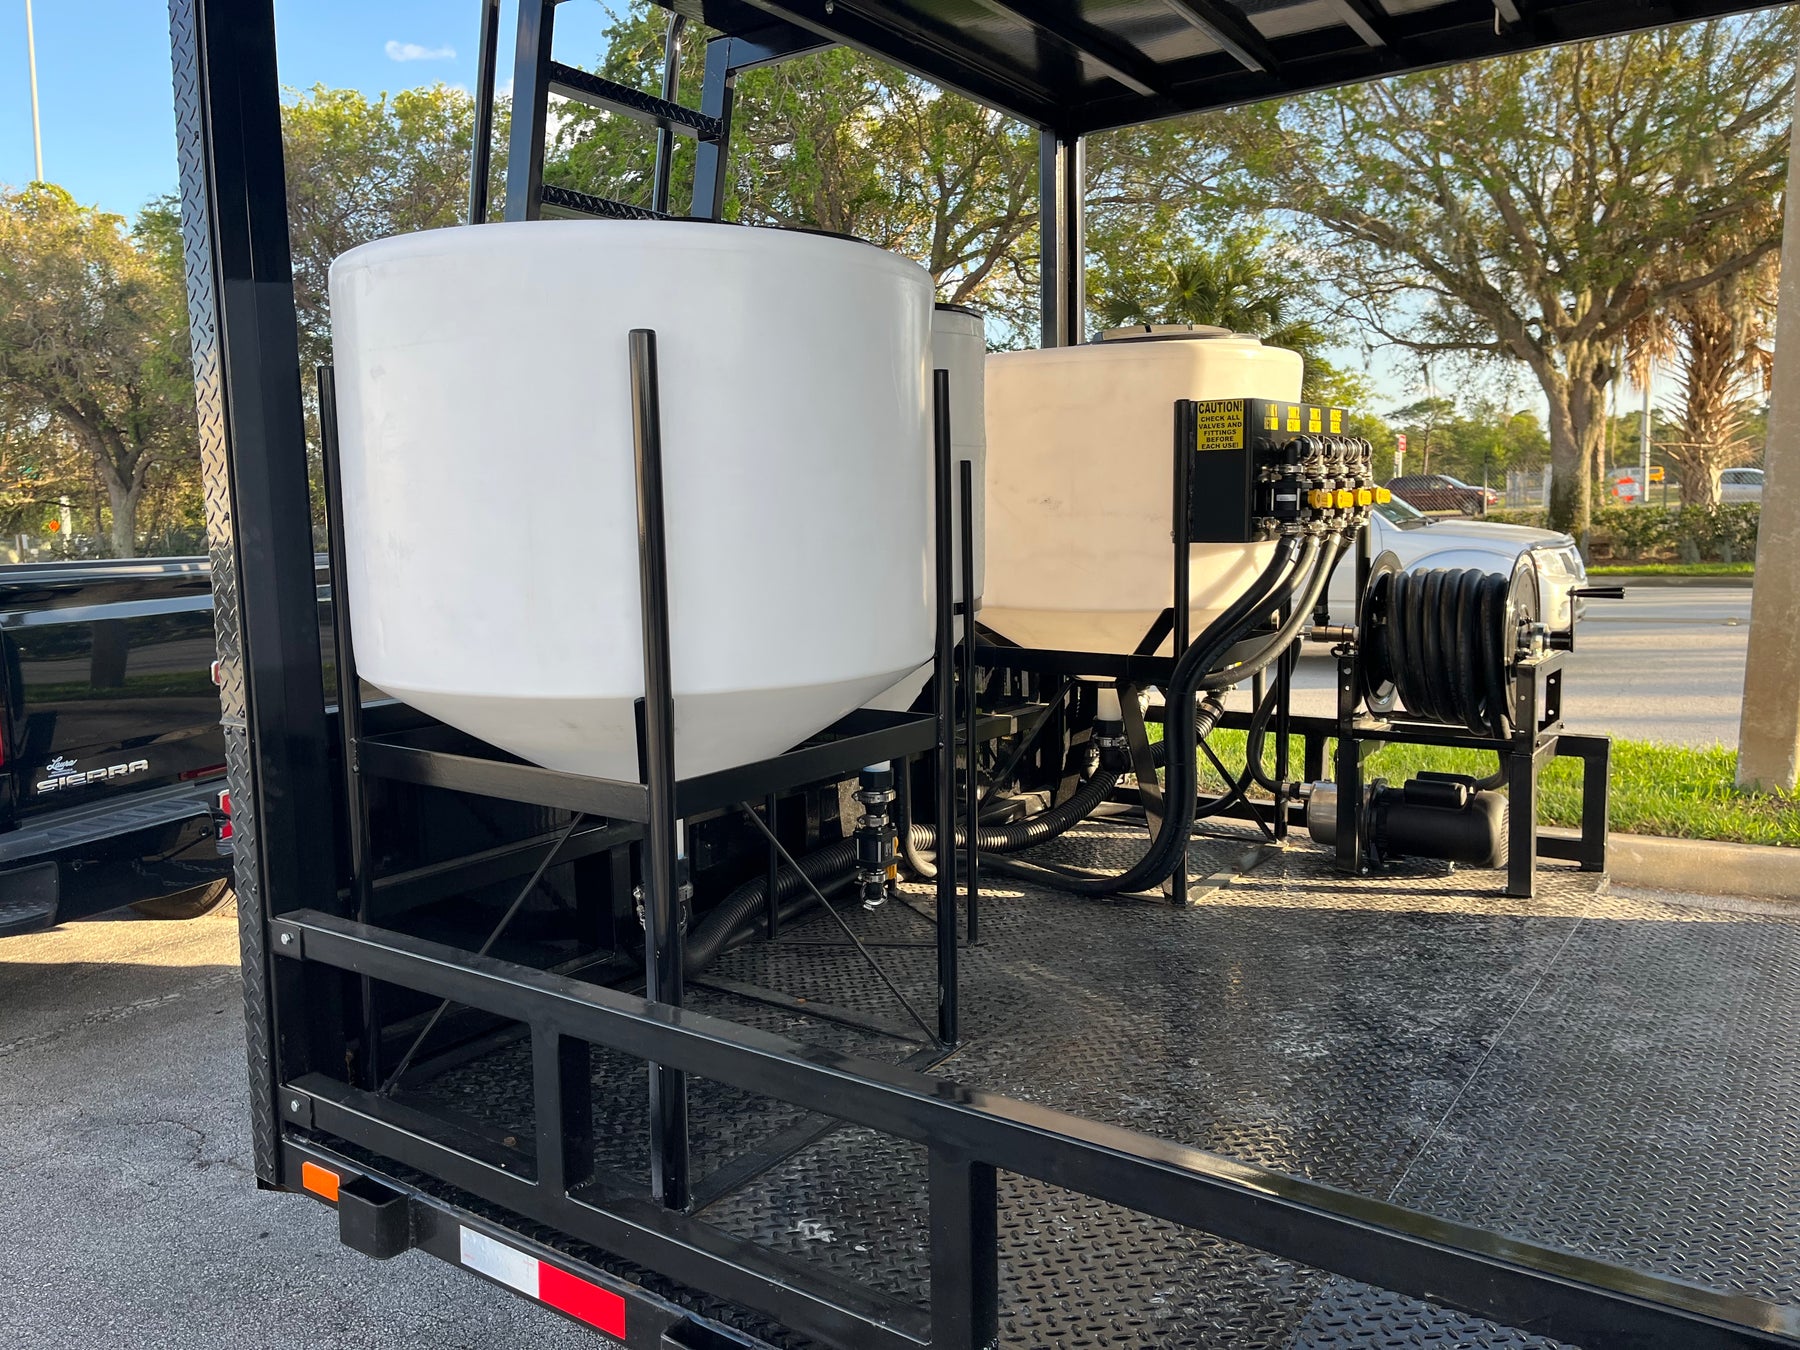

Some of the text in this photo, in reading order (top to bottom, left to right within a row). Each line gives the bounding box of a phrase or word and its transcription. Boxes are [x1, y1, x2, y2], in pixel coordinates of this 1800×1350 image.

[1198, 401, 1243, 414] CAUTION!
[1200, 415, 1225, 423] CHECK
[1198, 422, 1226, 430] VALVES
[1203, 429, 1237, 437] FITTINGS
[36, 759, 149, 795] SIERRA
